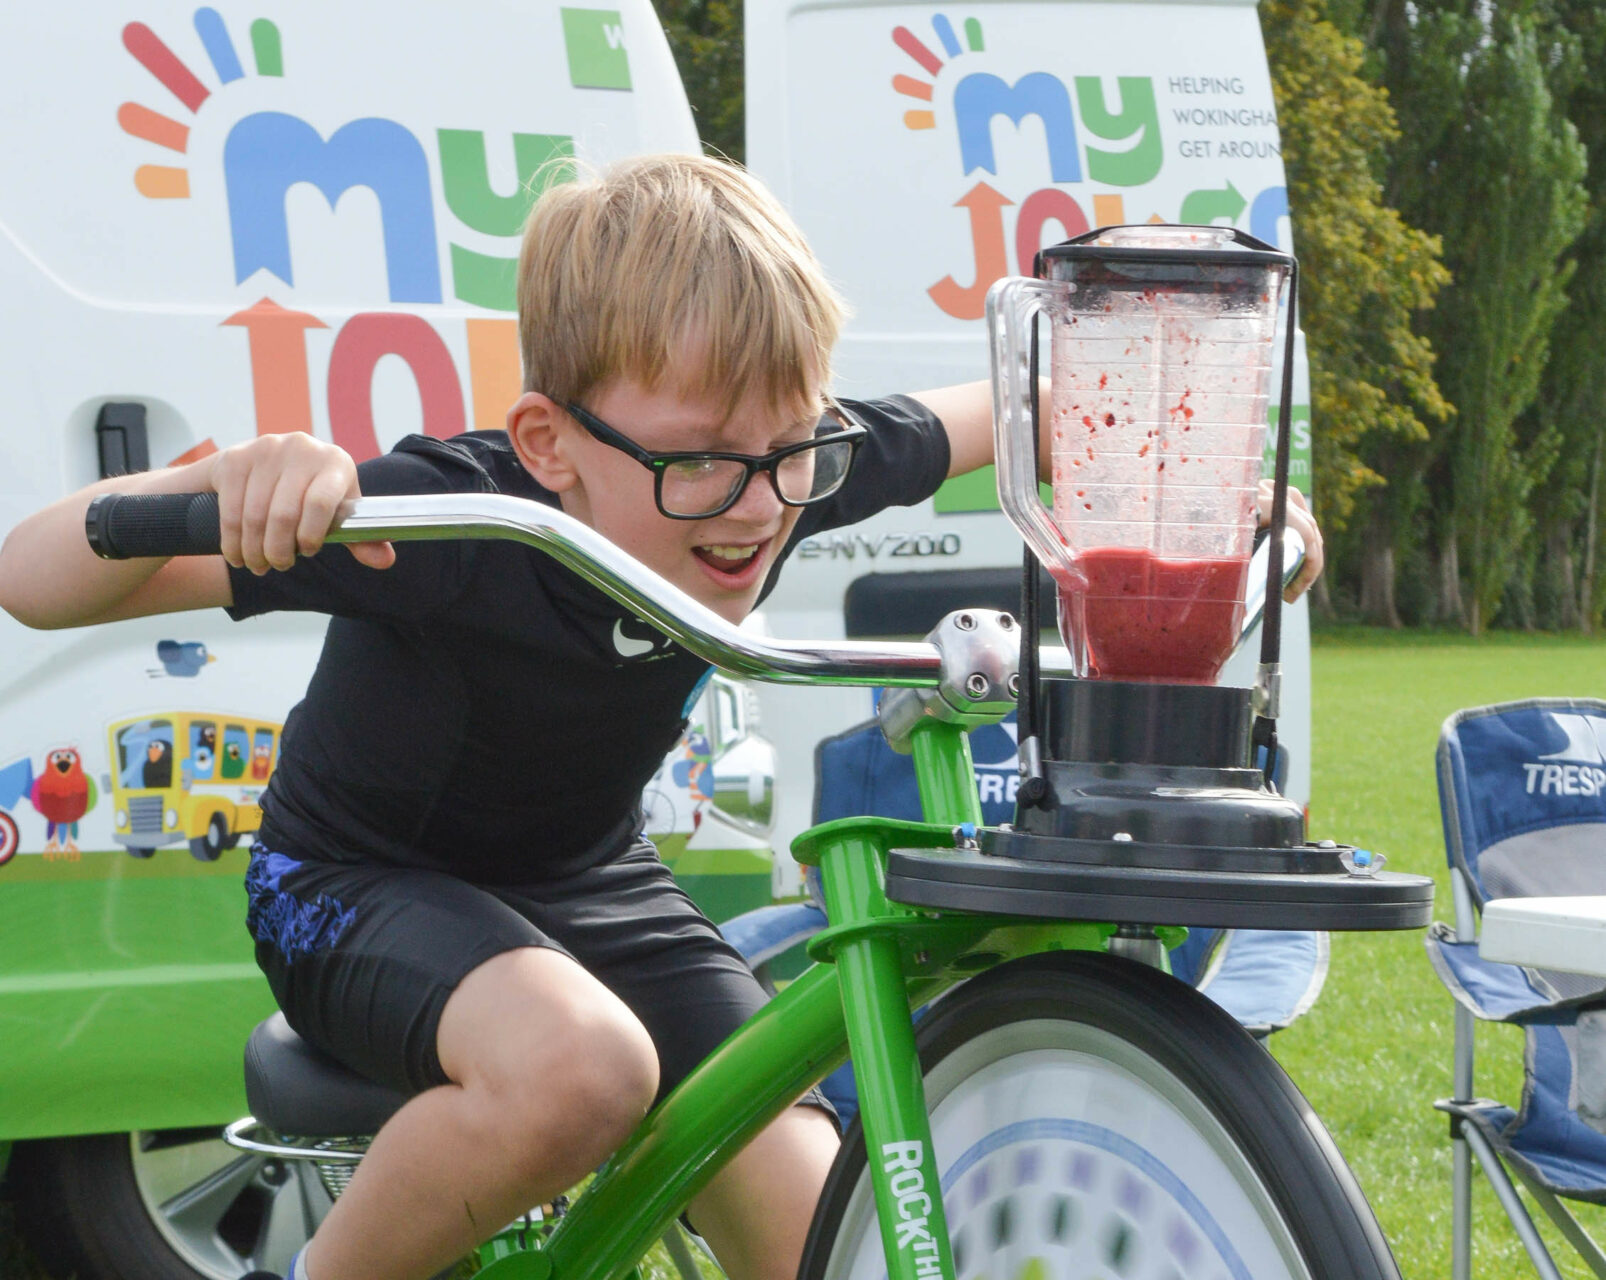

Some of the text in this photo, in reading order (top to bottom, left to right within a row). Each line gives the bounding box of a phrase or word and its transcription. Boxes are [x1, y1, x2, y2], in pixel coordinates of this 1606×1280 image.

[1168, 76, 1244, 95] HELPING
[953, 72, 1164, 186] my
[1172, 108, 1278, 126] WOKINGHA
[1179, 140, 1211, 158] GET
[223, 111, 576, 312] my
[1522, 762, 1606, 797] TRESP
[882, 1139, 932, 1251] ROCK
